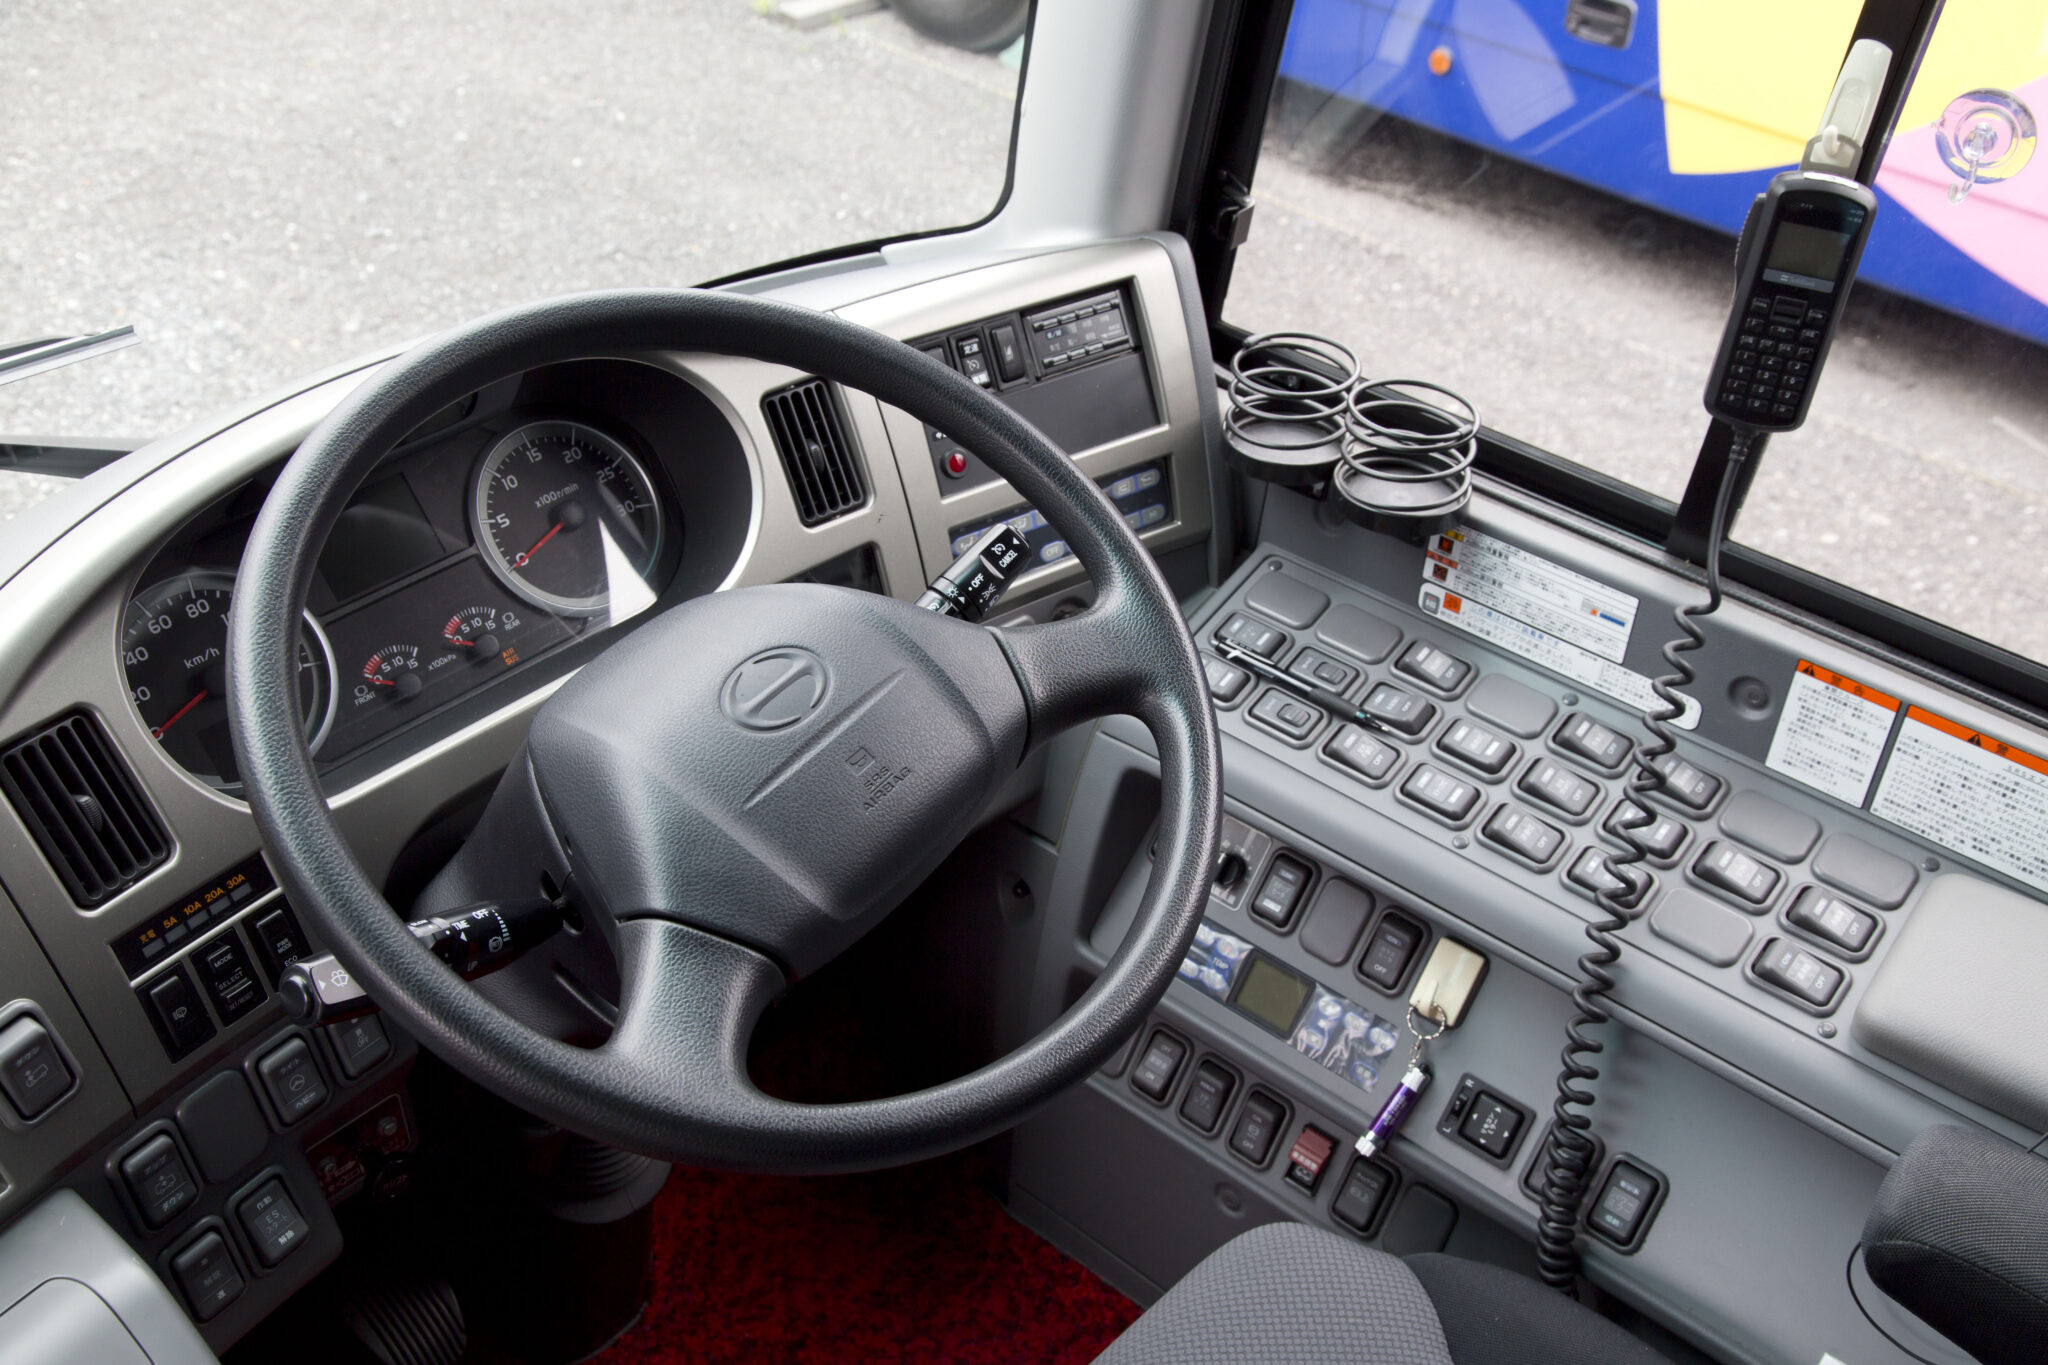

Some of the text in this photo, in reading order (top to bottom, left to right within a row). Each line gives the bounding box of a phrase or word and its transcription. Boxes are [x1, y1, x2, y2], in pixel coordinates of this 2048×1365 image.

[525, 447, 543, 464] 15
[561, 446, 583, 464] 20
[501, 474, 519, 491] 10
[596, 466, 616, 484] 25
[616, 500, 636, 518] 30
[495, 513, 511, 528] 5
[998, 549, 1019, 568] CANCEL
[971, 572, 985, 588] OFF
[184, 599, 210, 619] 80
[147, 615, 174, 635] 60
[461, 623, 471, 634] 5
[470, 617, 483, 629] 10
[485, 619, 497, 631] 15
[504, 618, 522, 631] REAR
[123, 646, 149, 666] 40
[183, 646, 220, 670] km/h
[502, 647, 514, 659] AIR
[504, 653, 520, 667] SUS
[381, 662, 392, 673] 5
[391, 655, 405, 668] 10
[406, 658, 419, 670] 15
[354, 690, 377, 706] FRONT
[863, 765, 890, 792] SRS
[863, 766, 912, 812] AIRBAG
[226, 873, 246, 889] 30A
[204, 886, 225, 903] 20A
[183, 900, 203, 916] 10A
[471, 908, 490, 920] OFF
[162, 915, 178, 929] 5A
[451, 919, 471, 931] TIME
[213, 952, 234, 970] MODE
[284, 954, 299, 968] ECO
[218, 970, 244, 991] SELECT
[1465, 1078, 1475, 1088] R
[265, 1208, 281, 1225] ES
